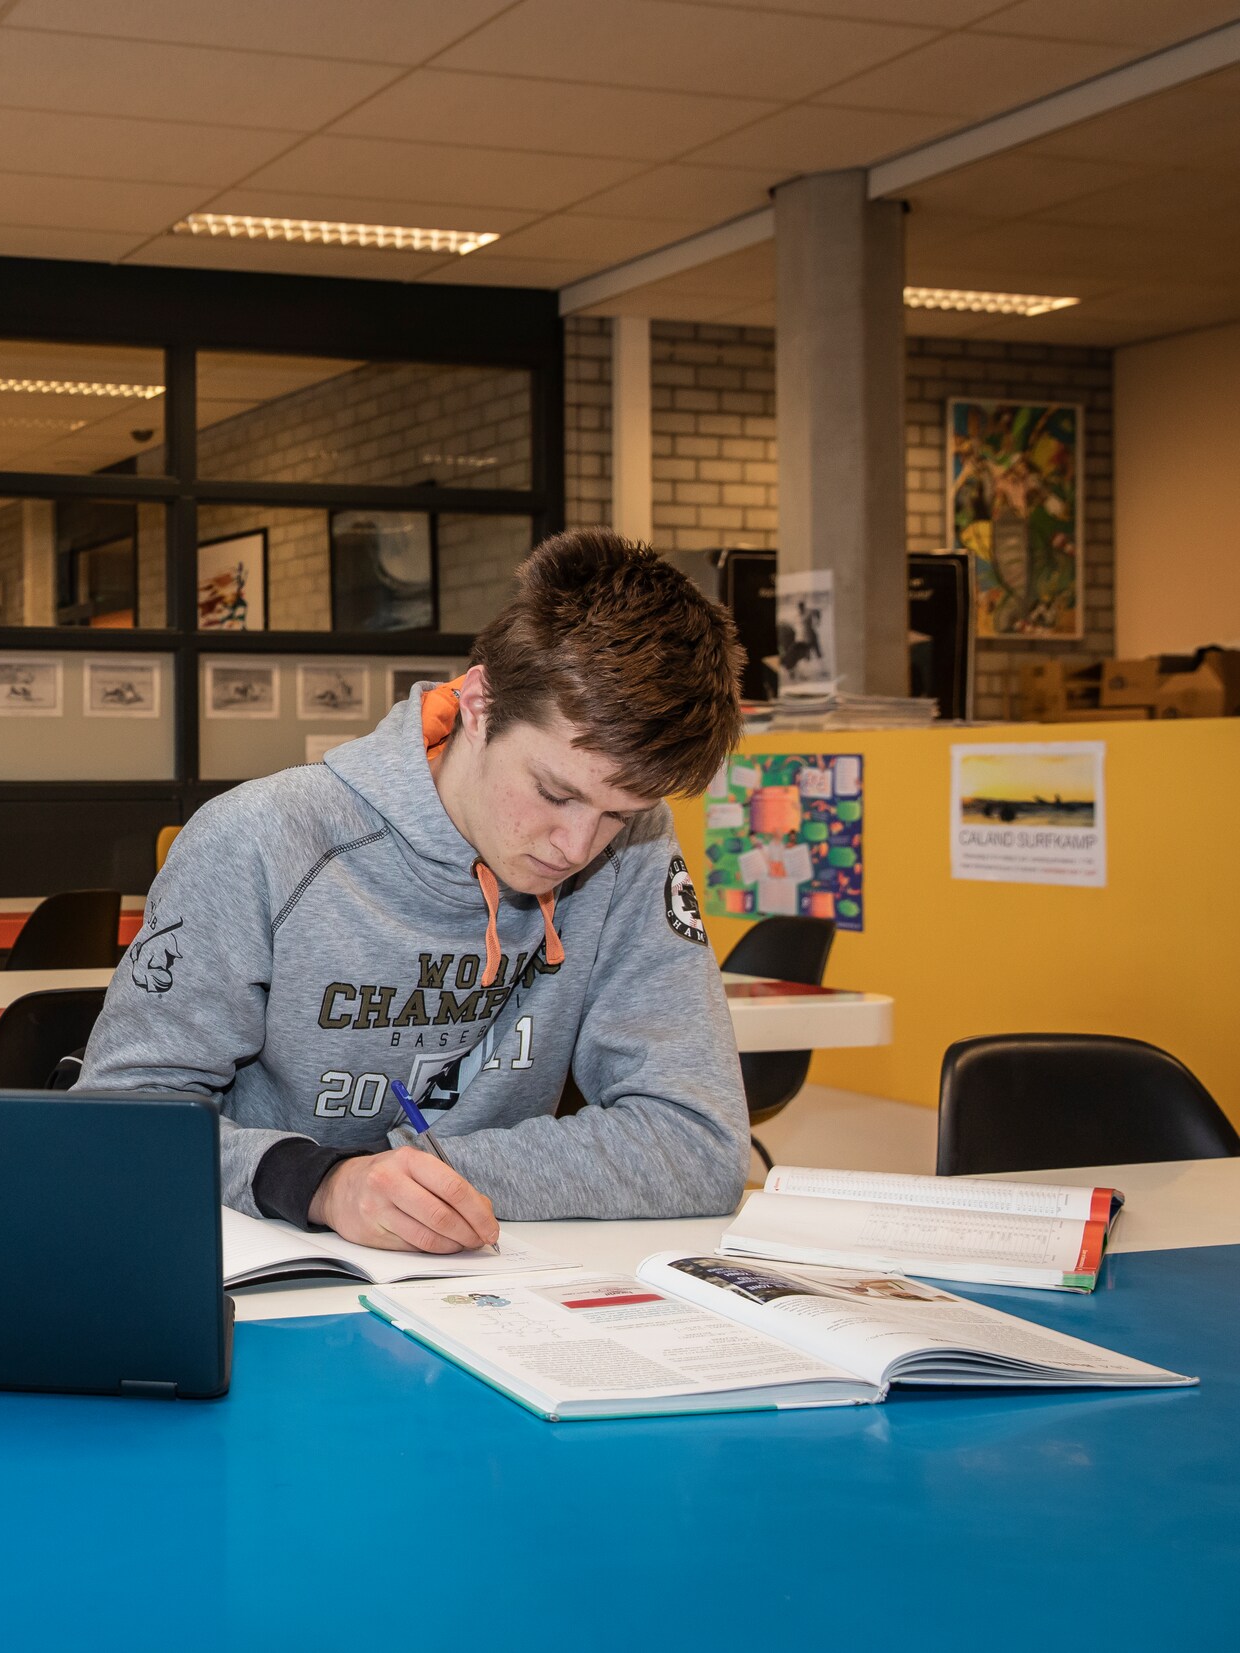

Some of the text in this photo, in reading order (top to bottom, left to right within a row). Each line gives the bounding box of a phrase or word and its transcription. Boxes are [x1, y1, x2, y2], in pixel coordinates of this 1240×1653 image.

[959, 830, 1098, 850] CALAND SURFKAMP
[667, 910, 706, 942] CHAM
[318, 982, 512, 1030] CHAMP
[390, 1025, 487, 1047] BASEB
[314, 1069, 389, 1118] 20
